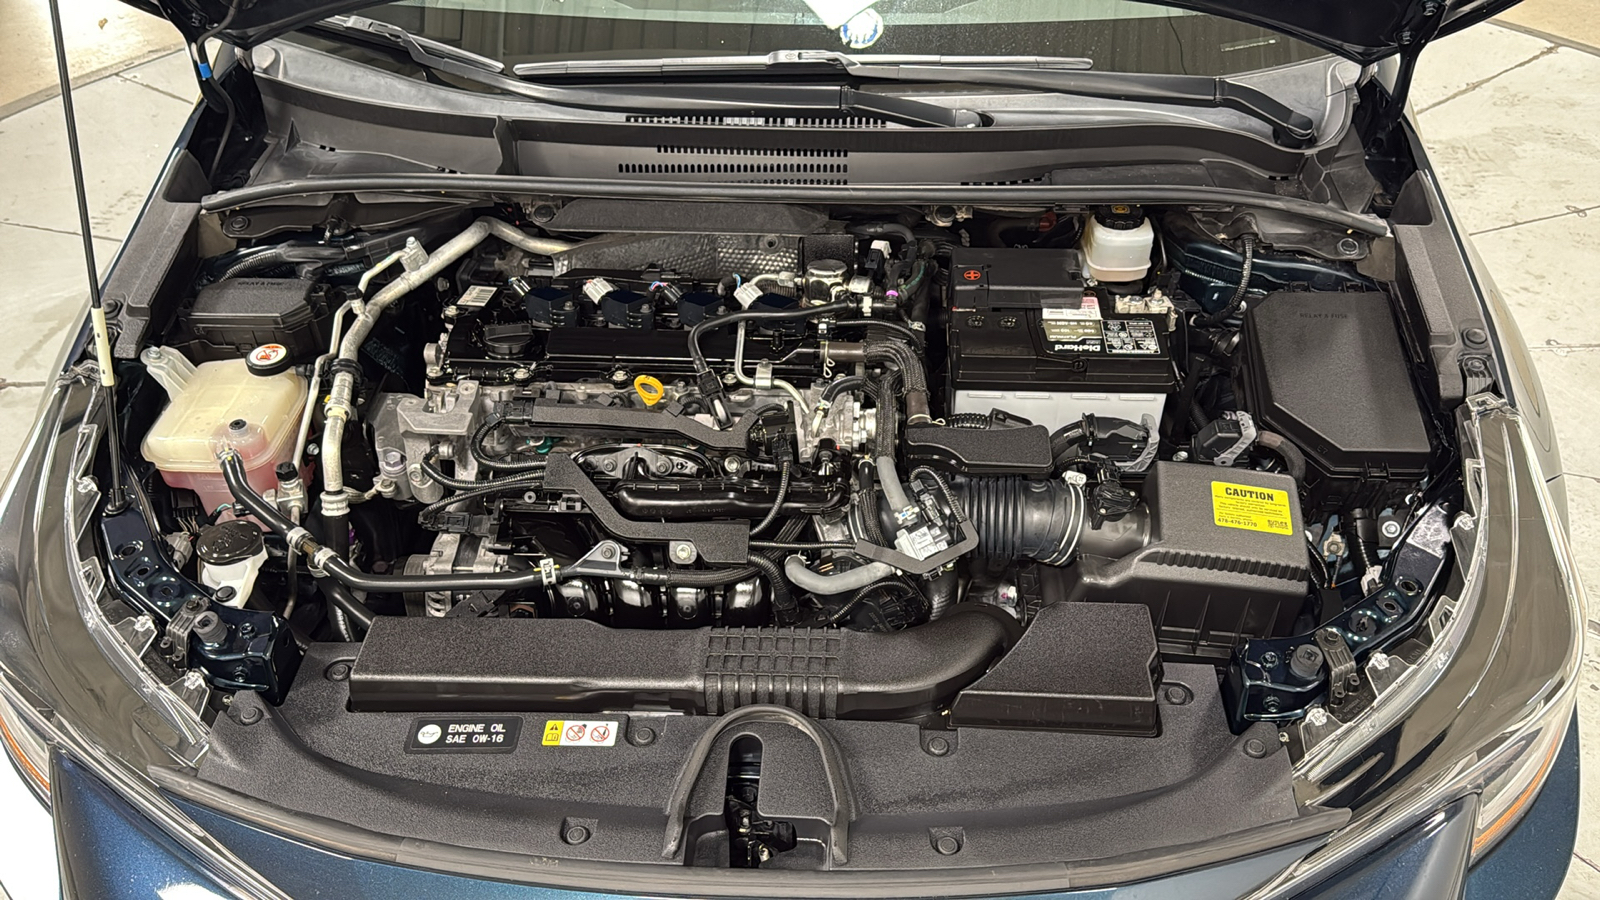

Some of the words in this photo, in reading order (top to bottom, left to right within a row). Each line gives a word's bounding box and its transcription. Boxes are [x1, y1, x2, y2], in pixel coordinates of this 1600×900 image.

[1055, 344, 1101, 352] DieHard
[1225, 487, 1274, 501] CAUTION
[448, 724, 485, 733] ENGINE
[490, 724, 506, 732] OIL
[445, 734, 467, 744] SAE
[472, 734, 504, 743] 0W-16
